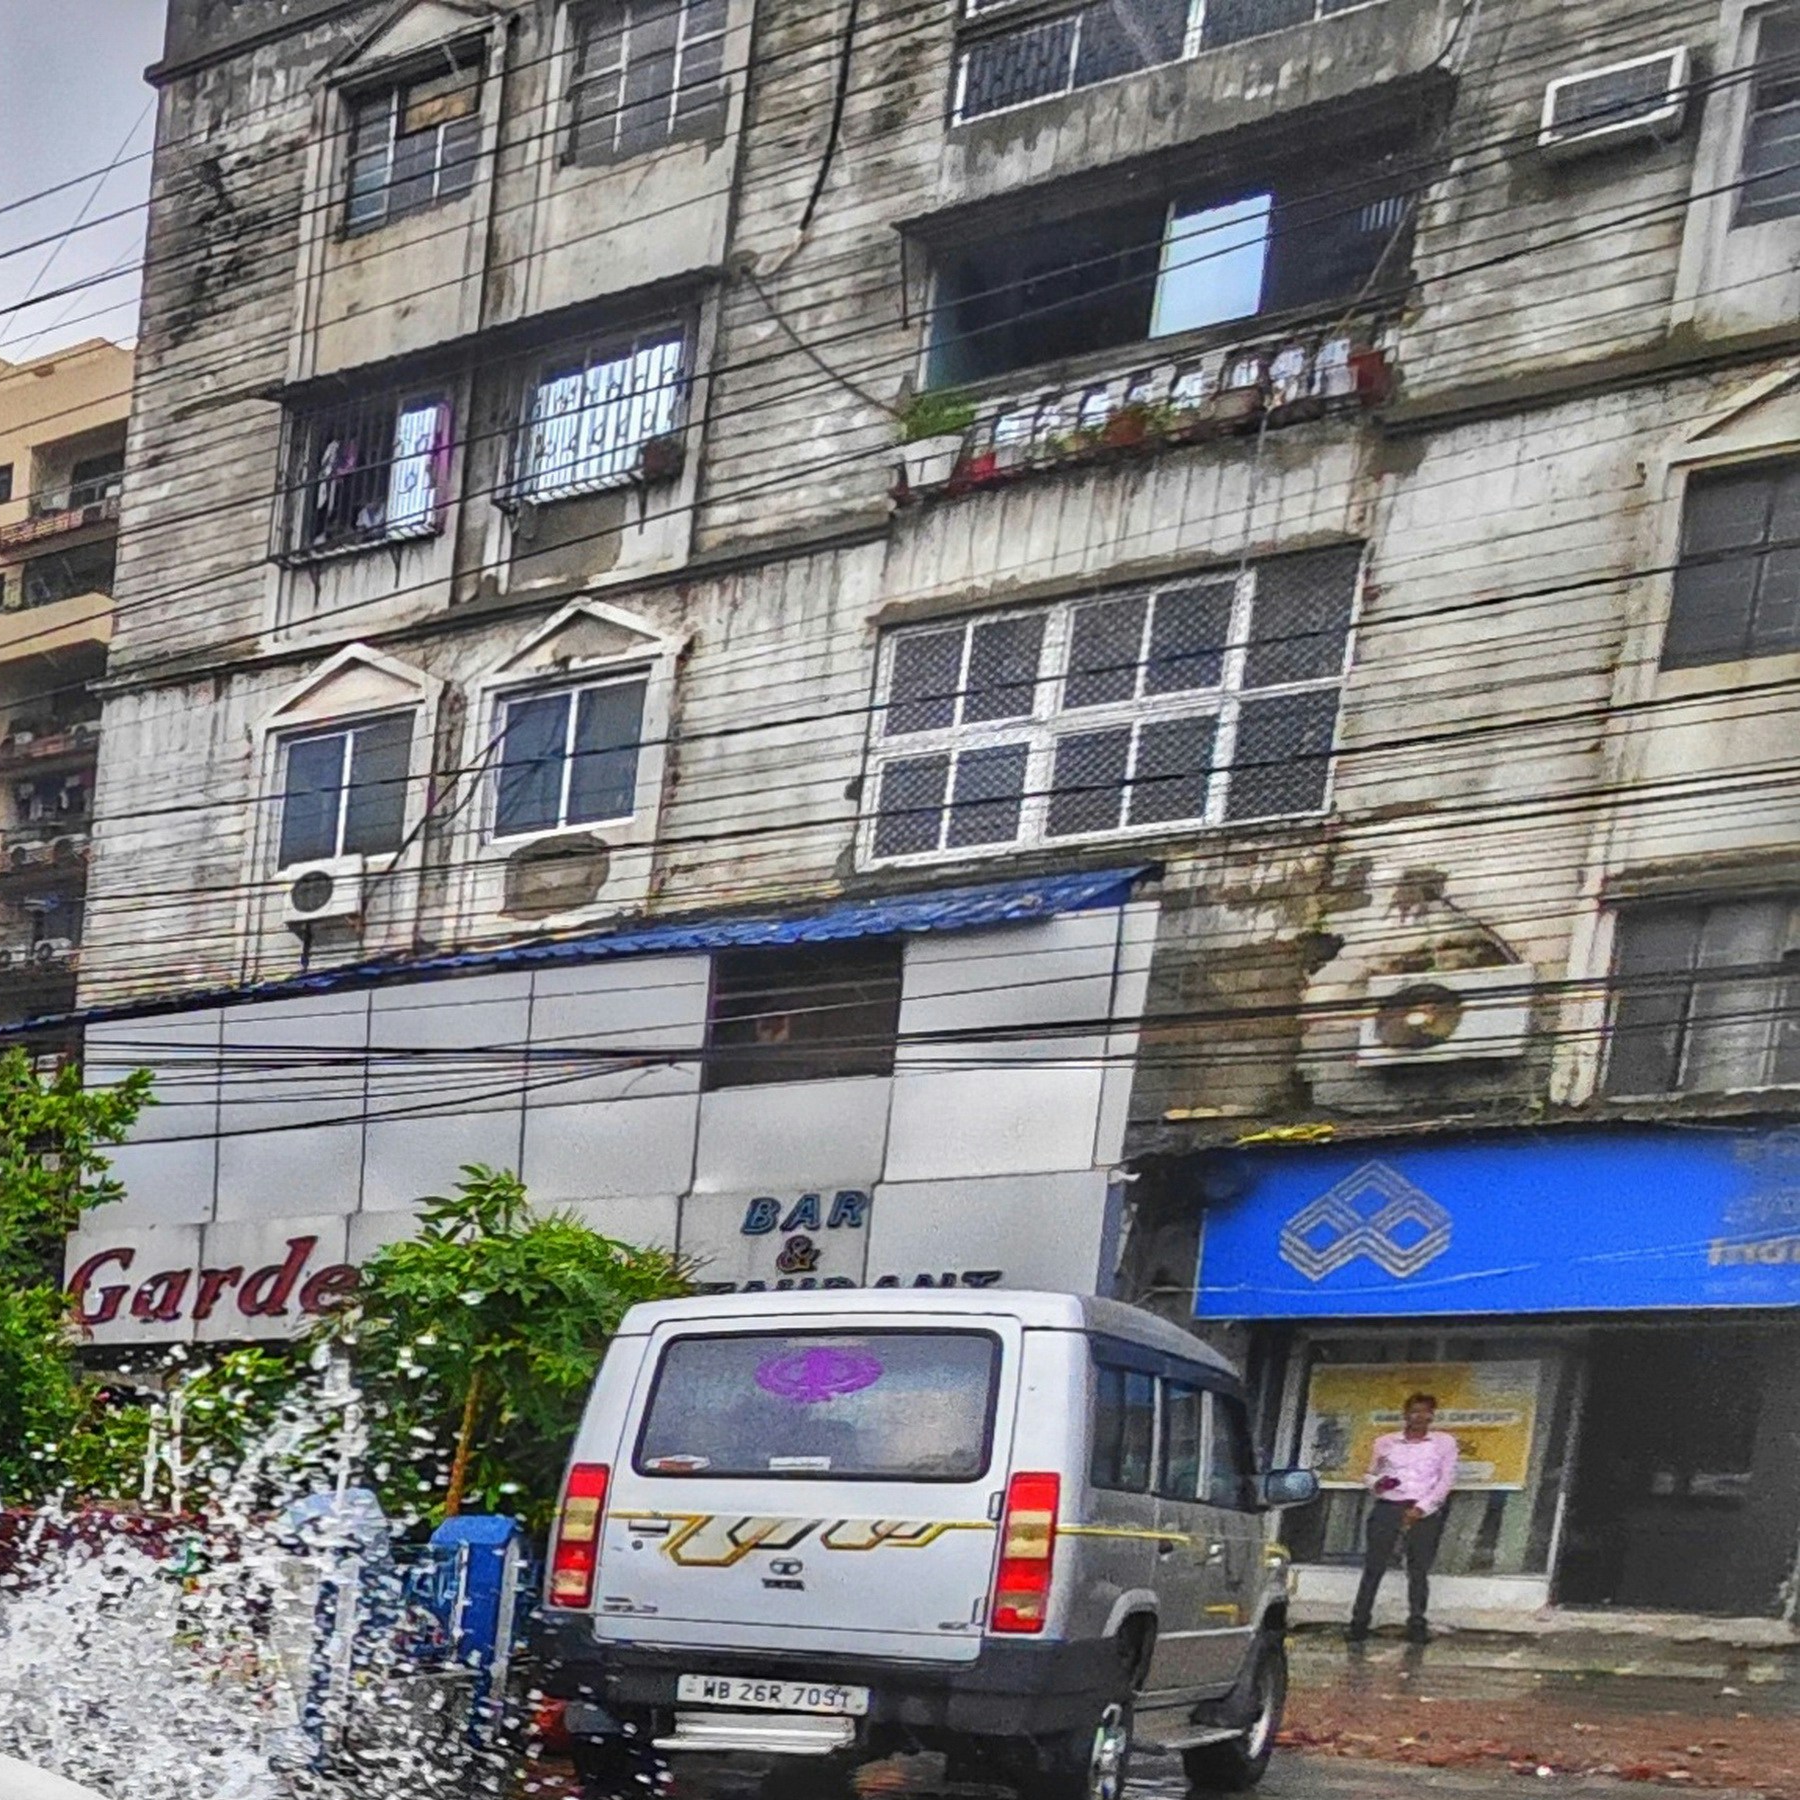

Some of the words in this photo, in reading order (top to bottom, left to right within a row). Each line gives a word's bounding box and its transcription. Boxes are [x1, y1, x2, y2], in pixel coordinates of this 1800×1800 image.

[740, 1189, 868, 1235] BAR
[775, 1235, 820, 1274] &
[67, 1235, 362, 1325] Garde
[703, 1677, 730, 1699] WB
[738, 1683, 782, 1704] 26R
